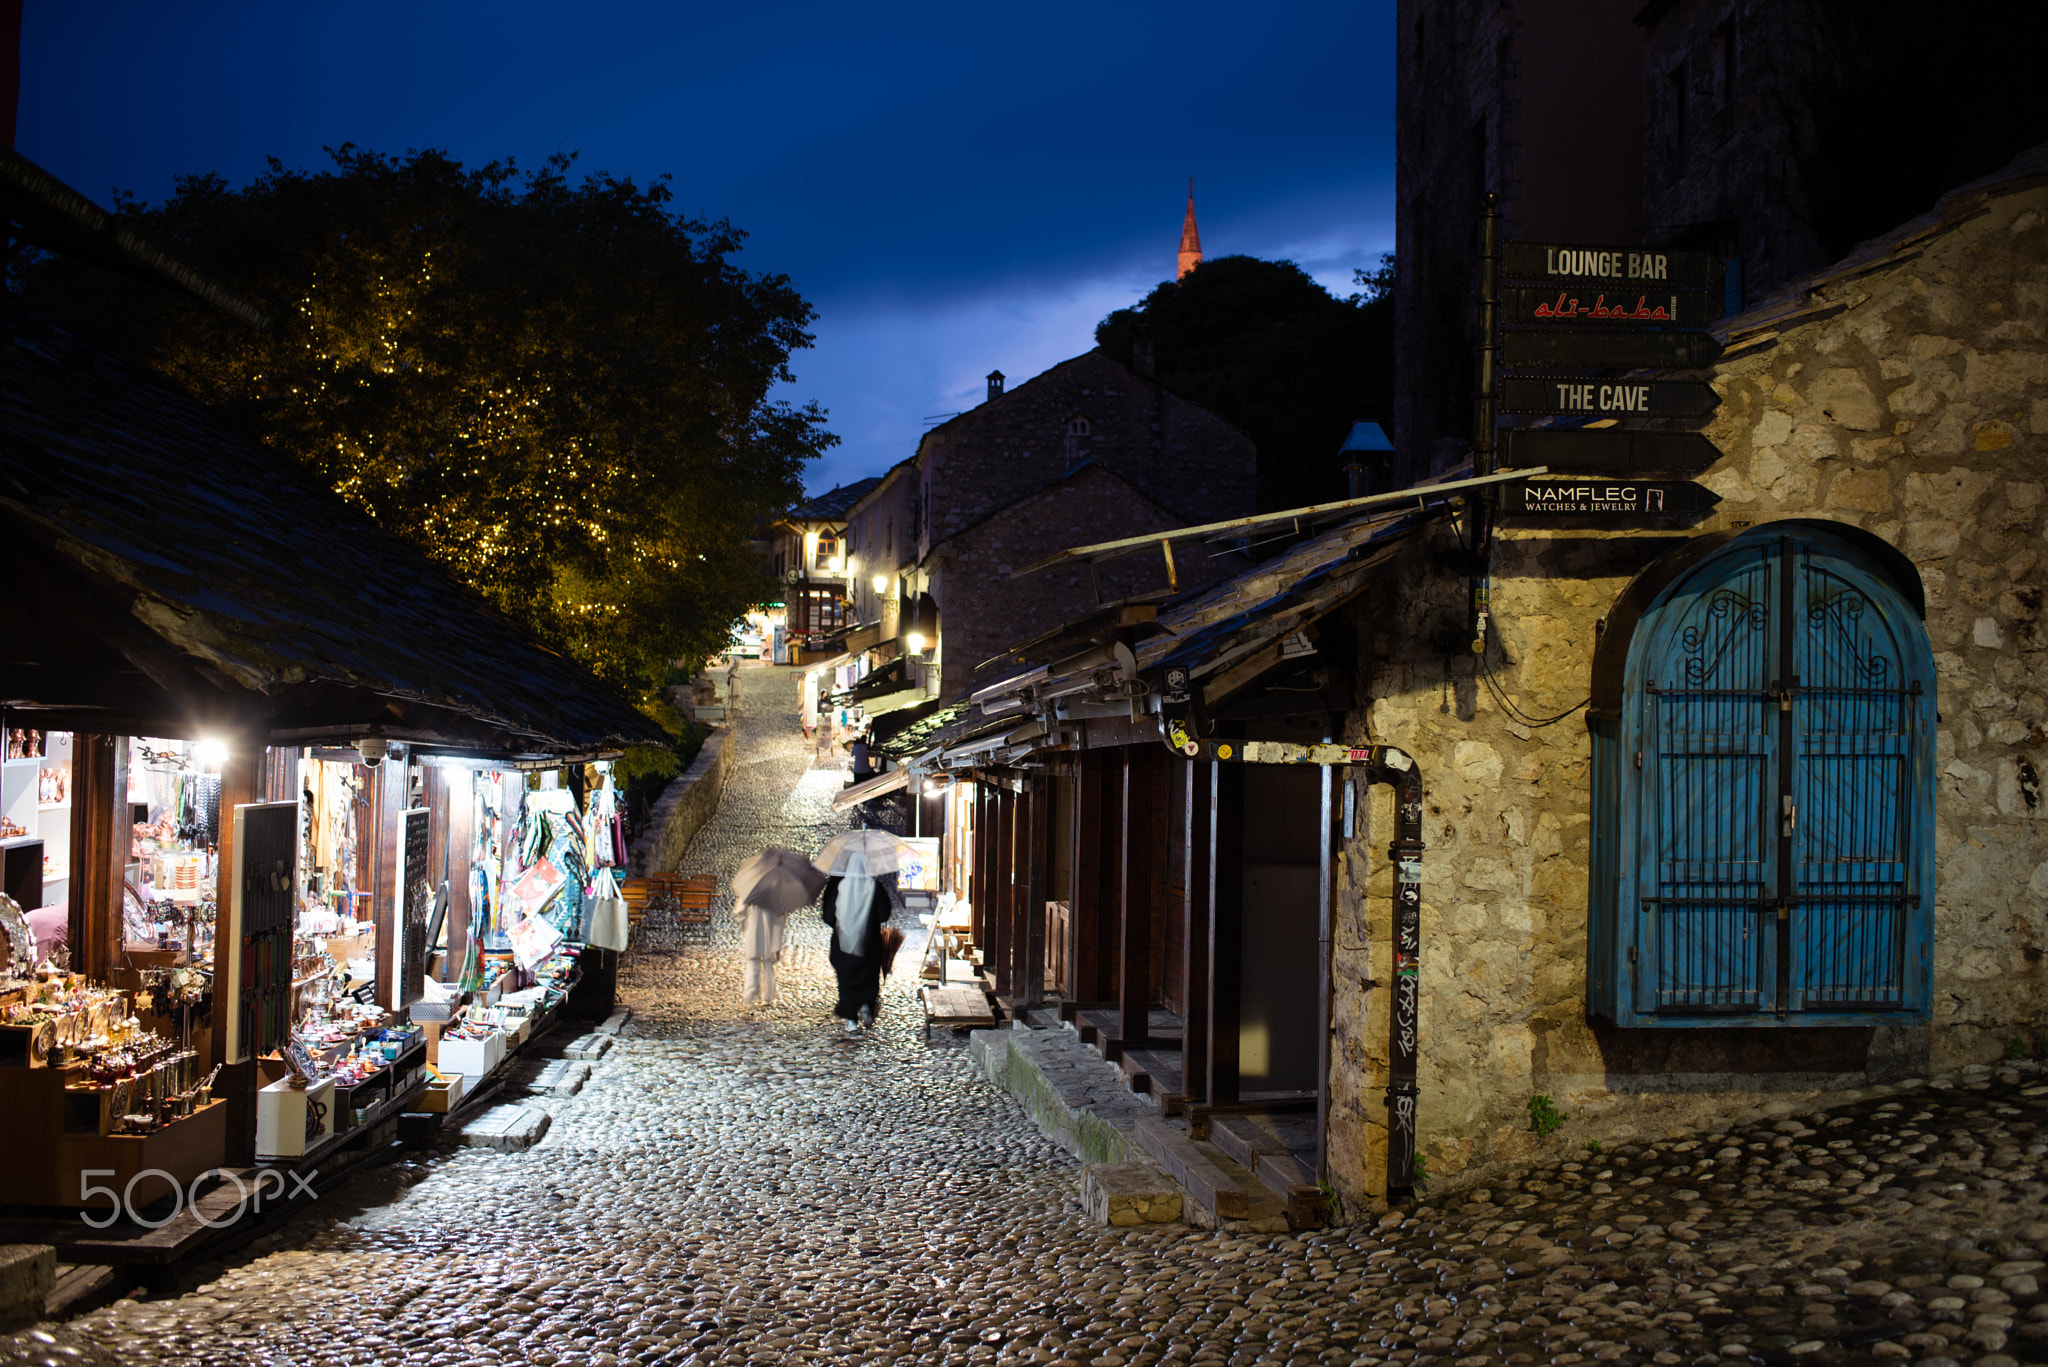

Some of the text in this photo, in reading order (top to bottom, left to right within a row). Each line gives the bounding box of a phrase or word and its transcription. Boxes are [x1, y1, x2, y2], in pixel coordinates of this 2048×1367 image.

[1547, 249, 1667, 280] LOUNGE BAR
[1557, 384, 1649, 412] THE CAVE
[1525, 487, 1637, 501] NAMFLEG
[1525, 502, 1638, 512] WATCHES & JEWELRY
